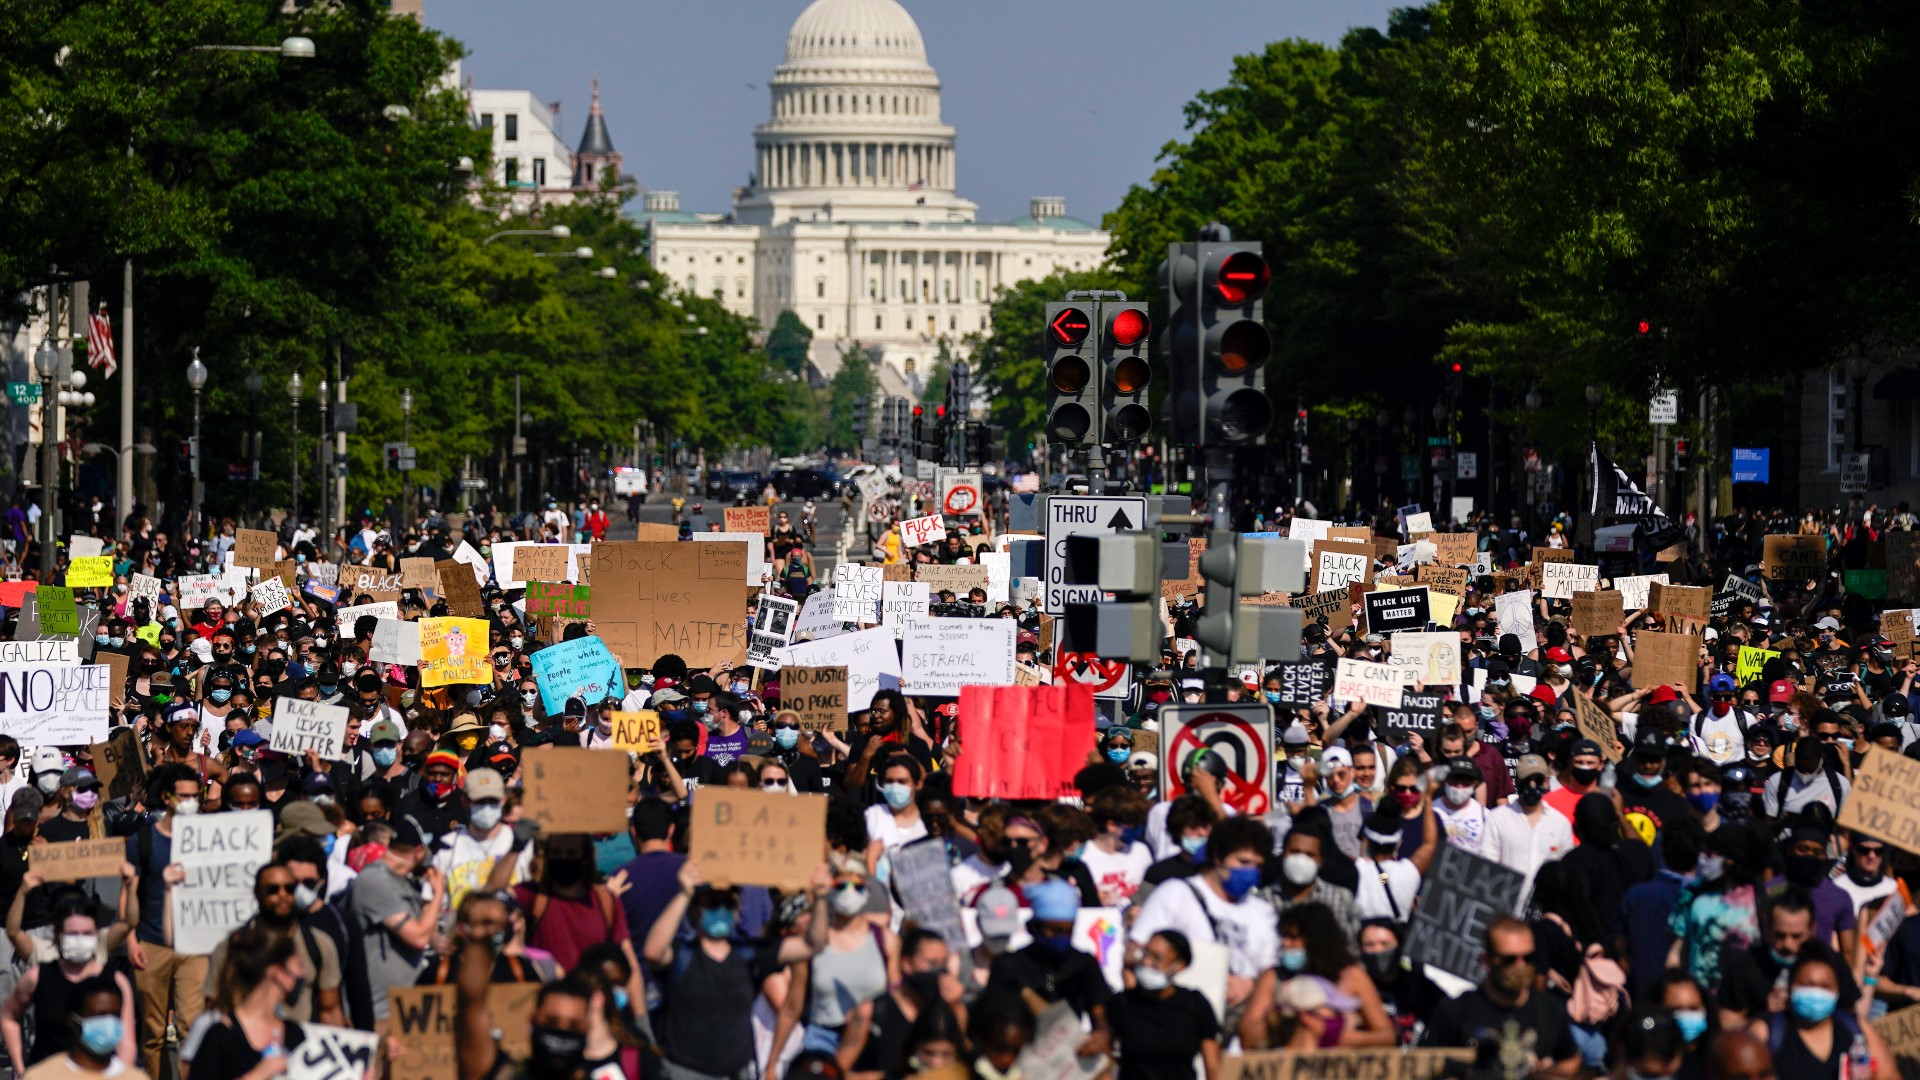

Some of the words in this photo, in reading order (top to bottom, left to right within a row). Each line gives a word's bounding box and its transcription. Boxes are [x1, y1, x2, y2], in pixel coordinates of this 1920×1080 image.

[727, 511, 744, 520] Non
[746, 510, 768, 518] Black
[1054, 505, 1096, 523] THRU
[731, 520, 768, 528] SILENCE
[905, 517, 943, 535] FUCK
[242, 534, 271, 546] BLACK
[917, 532, 928, 544] 12
[1442, 534, 1469, 543] ARREST
[1793, 537, 1803, 548] I
[246, 546, 267, 554] LIVES
[517, 549, 556, 558] BLACK
[238, 555, 270, 564] MATTER
[525, 558, 560, 567] LIVES
[596, 544, 673, 572] Black
[1323, 555, 1362, 571] BLACK
[1537, 551, 1574, 564] Racism
[515, 568, 559, 577] MATTER
[837, 566, 881, 583] BLACK
[1448, 570, 1463, 578] Black
[1547, 565, 1573, 577] BLACK
[1578, 565, 1598, 580] LIVES
[1771, 565, 1821, 579] BREATHE
[134, 576, 160, 595] BLACK
[358, 573, 403, 591] BLACK
[957, 581, 983, 589] AGAIN
[1321, 572, 1360, 587] LIVES
[1435, 576, 1450, 584] SEE
[253, 582, 281, 598] BLACK
[532, 584, 537, 597] I
[638, 581, 691, 604] Lives
[836, 584, 879, 600] LIVES
[898, 584, 912, 596] NO
[1172, 584, 1192, 594] PEACE
[1555, 580, 1590, 595] MATTER
[1295, 592, 1323, 608] BLACK
[1323, 588, 1348, 602] LIVES
[1373, 598, 1396, 607] BLACK
[1401, 595, 1420, 604] LIVES
[261, 599, 289, 613] MATTER
[526, 600, 590, 615] BREATHE
[770, 601, 795, 612] BREATHE
[834, 601, 878, 615] MATTER
[885, 602, 924, 612] JUSTICE
[1305, 602, 1342, 619] MATTER
[1385, 609, 1413, 618] MATTER
[1885, 613, 1907, 627] BLACK
[423, 623, 443, 631] BLACK
[906, 620, 931, 630] There
[980, 623, 994, 631] time
[423, 631, 441, 639] LIVES
[655, 621, 744, 651] MATTER
[760, 636, 784, 647] KILLER
[1889, 630, 1909, 640] LIVES
[751, 645, 772, 654] COPS
[853, 638, 873, 654] for
[535, 651, 556, 663] There
[577, 650, 600, 660] white
[913, 653, 975, 668] BETRAYAL
[428, 657, 465, 671] DEFUND
[469, 657, 487, 668] THE
[443, 669, 476, 681] POLICE
[547, 667, 571, 681] people
[786, 670, 808, 684] NO
[811, 669, 847, 684] JUSTICE
[0, 670, 54, 712] NO
[55, 667, 110, 690] JUSTICE
[550, 682, 567, 692] public
[569, 673, 591, 684] health
[1282, 665, 1296, 703] BLACK
[1297, 665, 1312, 704] LIVES
[55, 689, 109, 711] PEACE
[782, 700, 805, 712] NO
[808, 695, 843, 710] PEACE
[1403, 695, 1439, 709] RACIST
[287, 700, 318, 717] BLACK
[295, 719, 334, 736] LIVES
[1387, 712, 1436, 730] POLICE
[617, 719, 657, 745] ACAB
[274, 731, 334, 755] MATTER
[181, 825, 259, 854] BLACK
[181, 862, 255, 889] LIVES
[1439, 849, 1521, 905] BLACK
